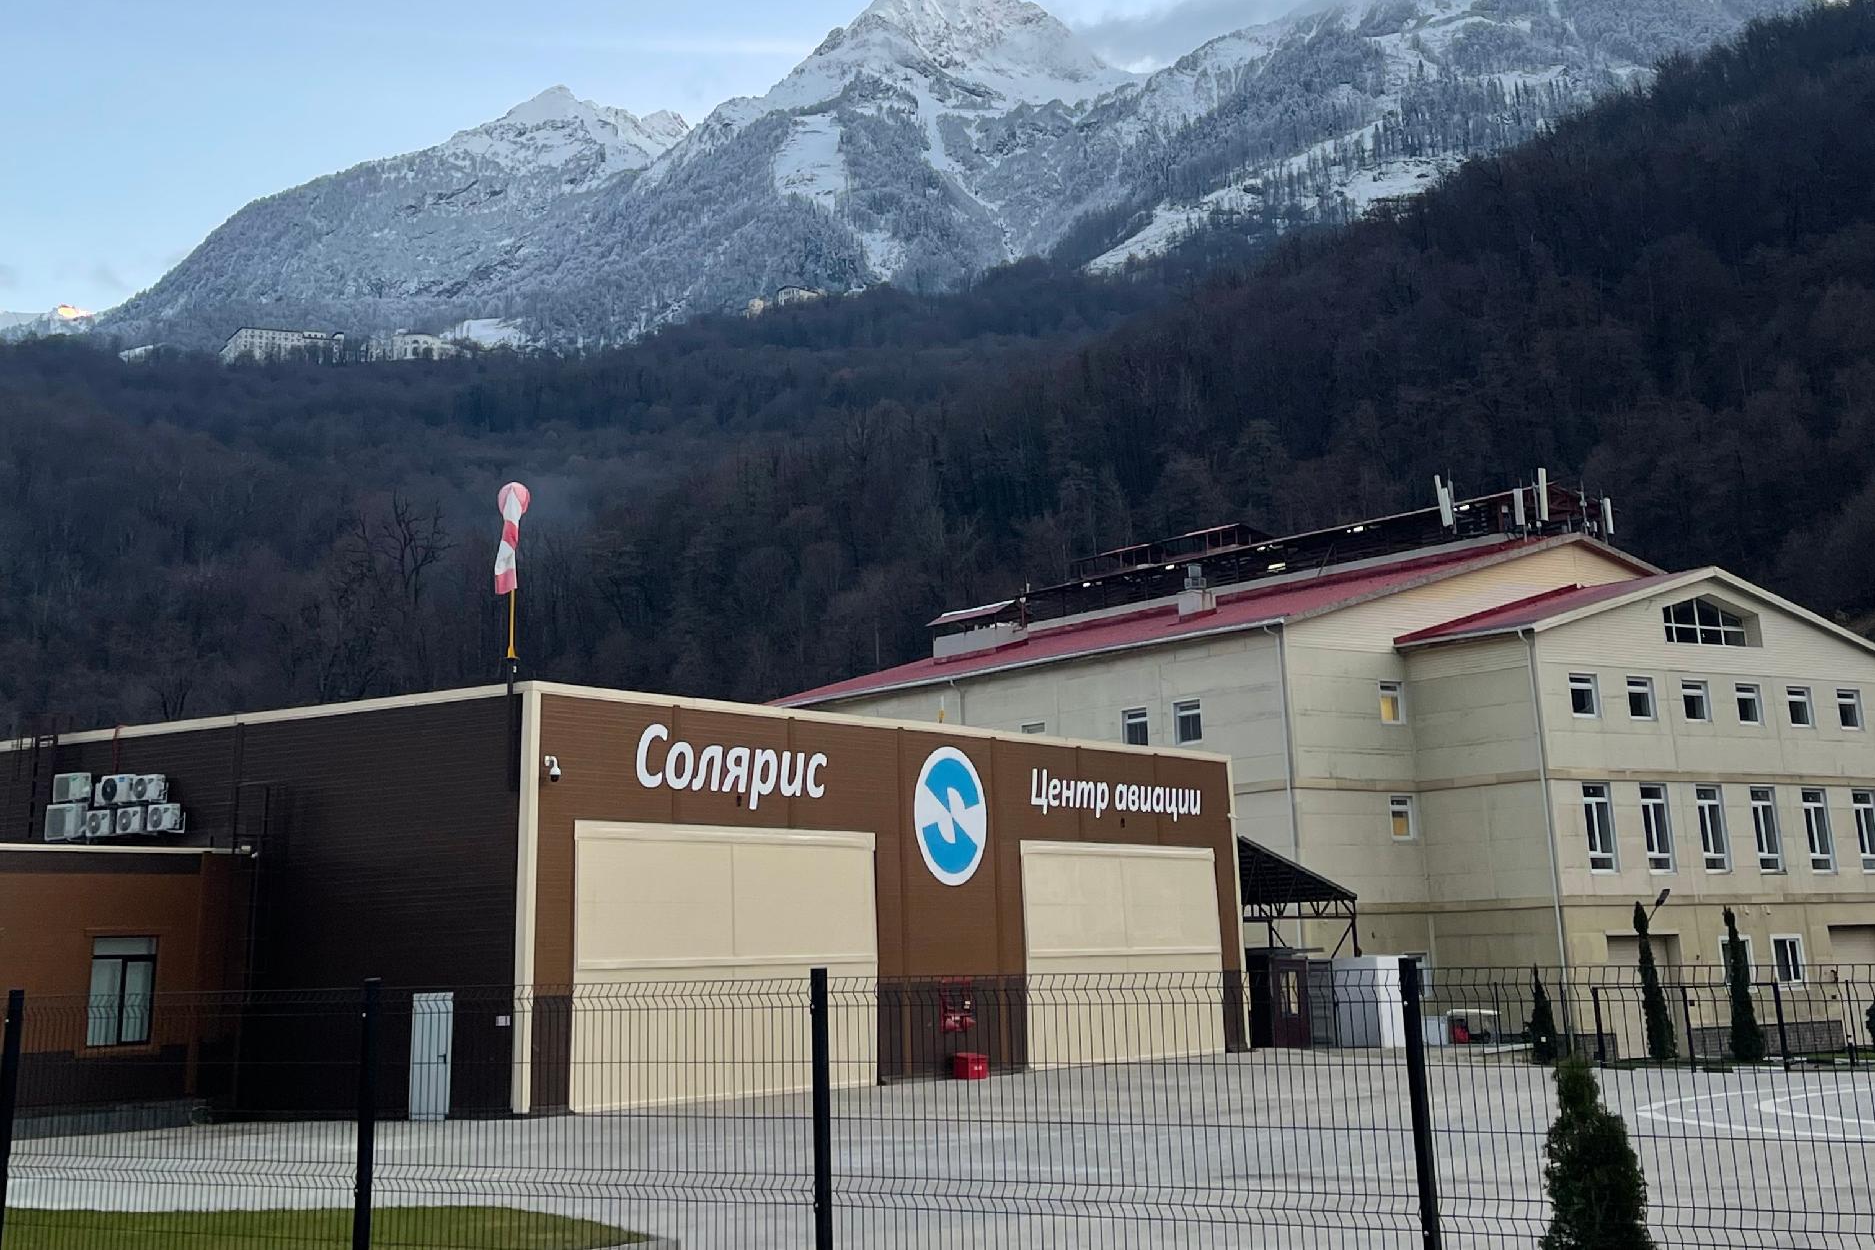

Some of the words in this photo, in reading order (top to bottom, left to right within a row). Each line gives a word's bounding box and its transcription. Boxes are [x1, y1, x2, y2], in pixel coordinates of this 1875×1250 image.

[636, 723, 828, 810] Солярис
[1030, 768, 1110, 819] Центр
[1114, 783, 1201, 822] авиации
